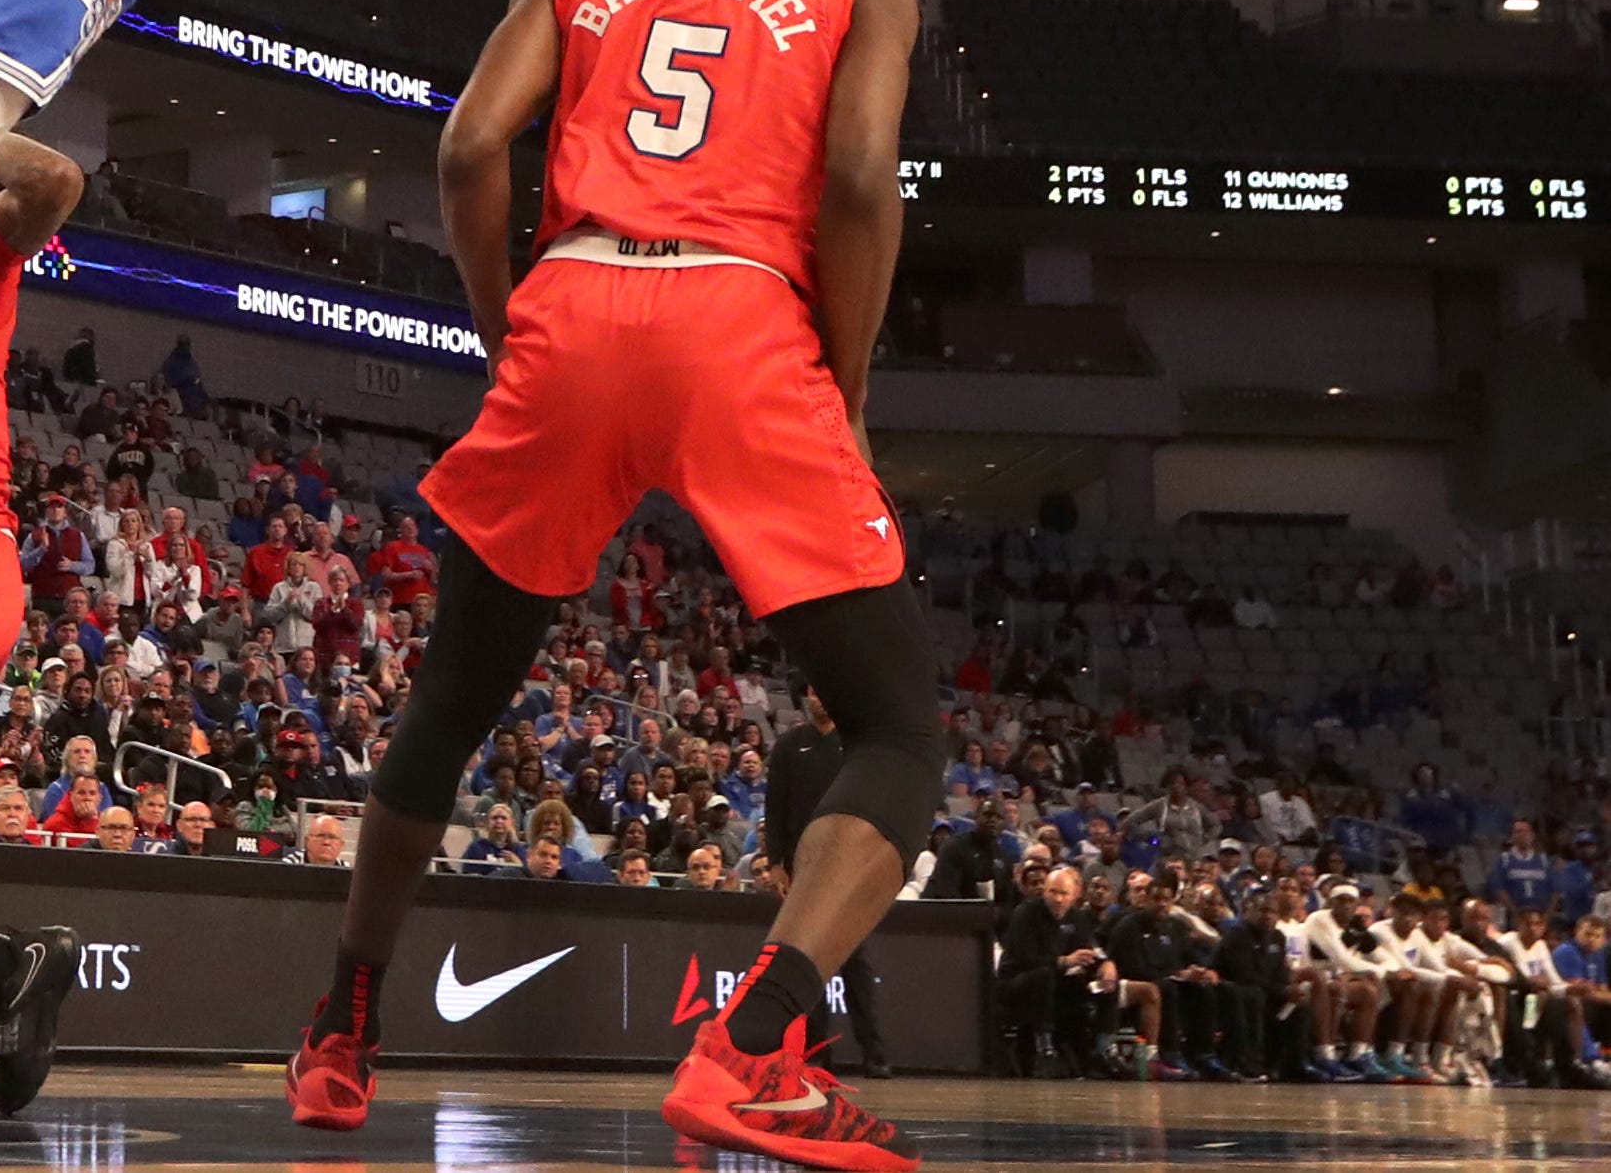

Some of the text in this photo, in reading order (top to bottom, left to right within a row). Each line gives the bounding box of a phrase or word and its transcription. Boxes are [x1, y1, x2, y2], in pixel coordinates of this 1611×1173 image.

[178, 16, 432, 106] BRING THE POWER HOME
[626, 18, 730, 161] 5
[896, 160, 926, 178] EY
[1048, 165, 1188, 186] 2 PTS 1 FLS
[1224, 170, 1349, 191] 11 QUINONES
[1445, 176, 1586, 198] 0 PTS 0 FLS
[1048, 186, 1188, 207] 4 PTS 0 FLS
[1222, 191, 1344, 212] 12 WILLIAMS
[1448, 198, 1587, 219] 5 PTS 1 FLS
[238, 284, 305, 322] BRING
[308, 297, 352, 332] THE
[355, 308, 429, 348] POWER
[366, 363, 400, 394] 110
